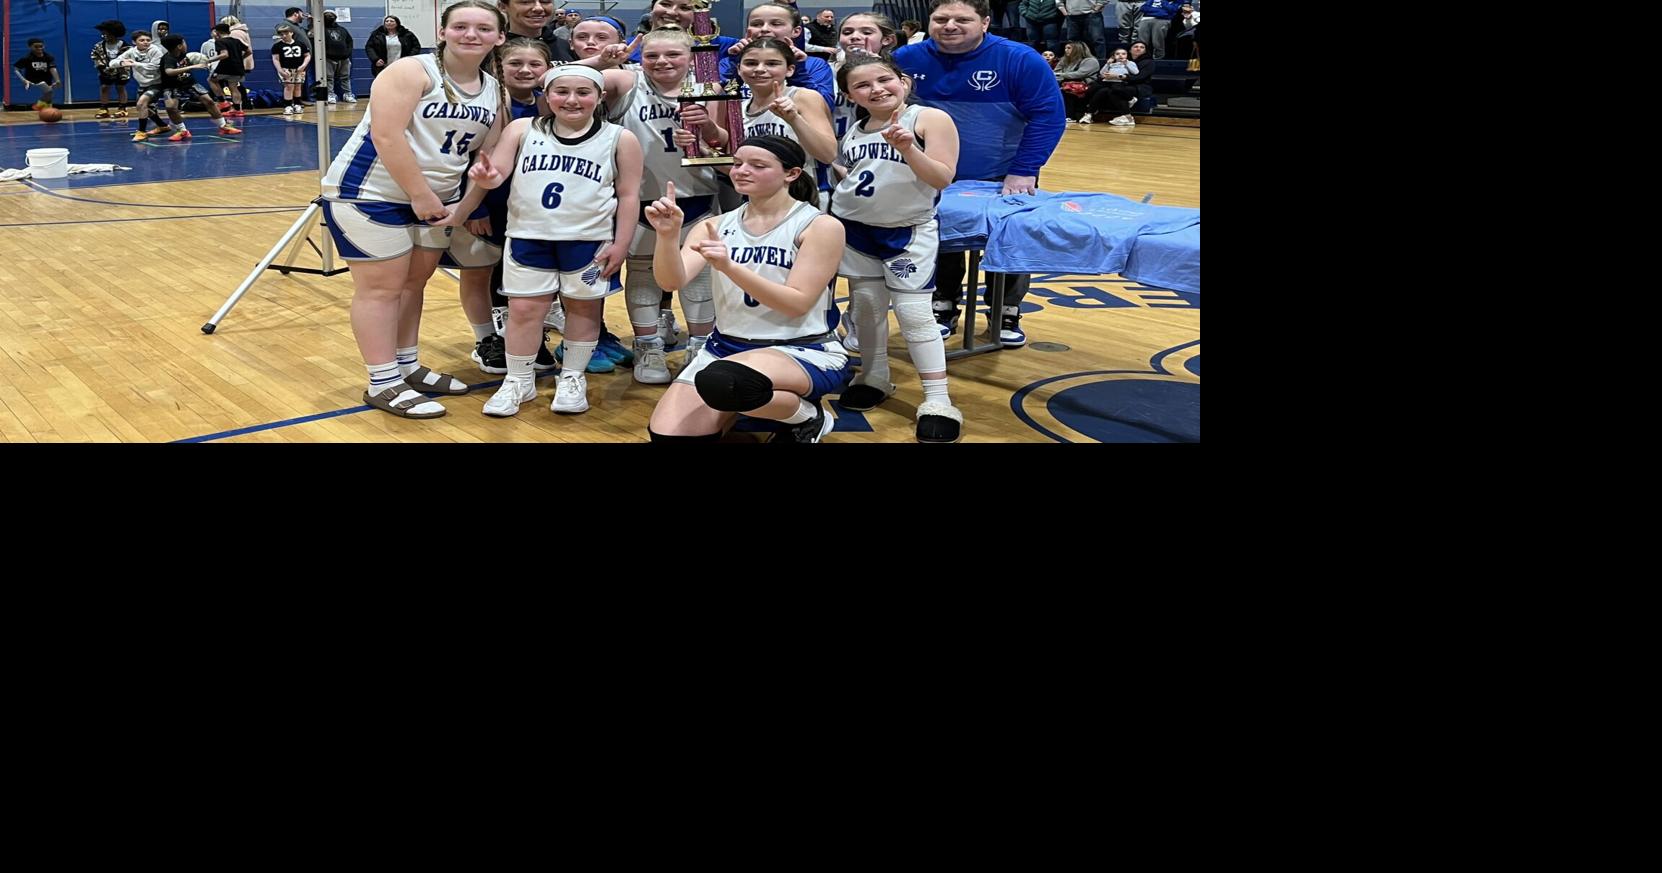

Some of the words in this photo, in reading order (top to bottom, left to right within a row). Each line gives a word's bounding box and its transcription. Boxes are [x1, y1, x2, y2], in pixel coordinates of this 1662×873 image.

[283, 46, 301, 57] 23
[422, 102, 496, 129] CALDWEL
[440, 129, 476, 156] 15
[522, 154, 602, 183] CALDWELL
[541, 182, 564, 209] 6
[855, 170, 875, 197] 2
[730, 245, 793, 270] LDWEL
